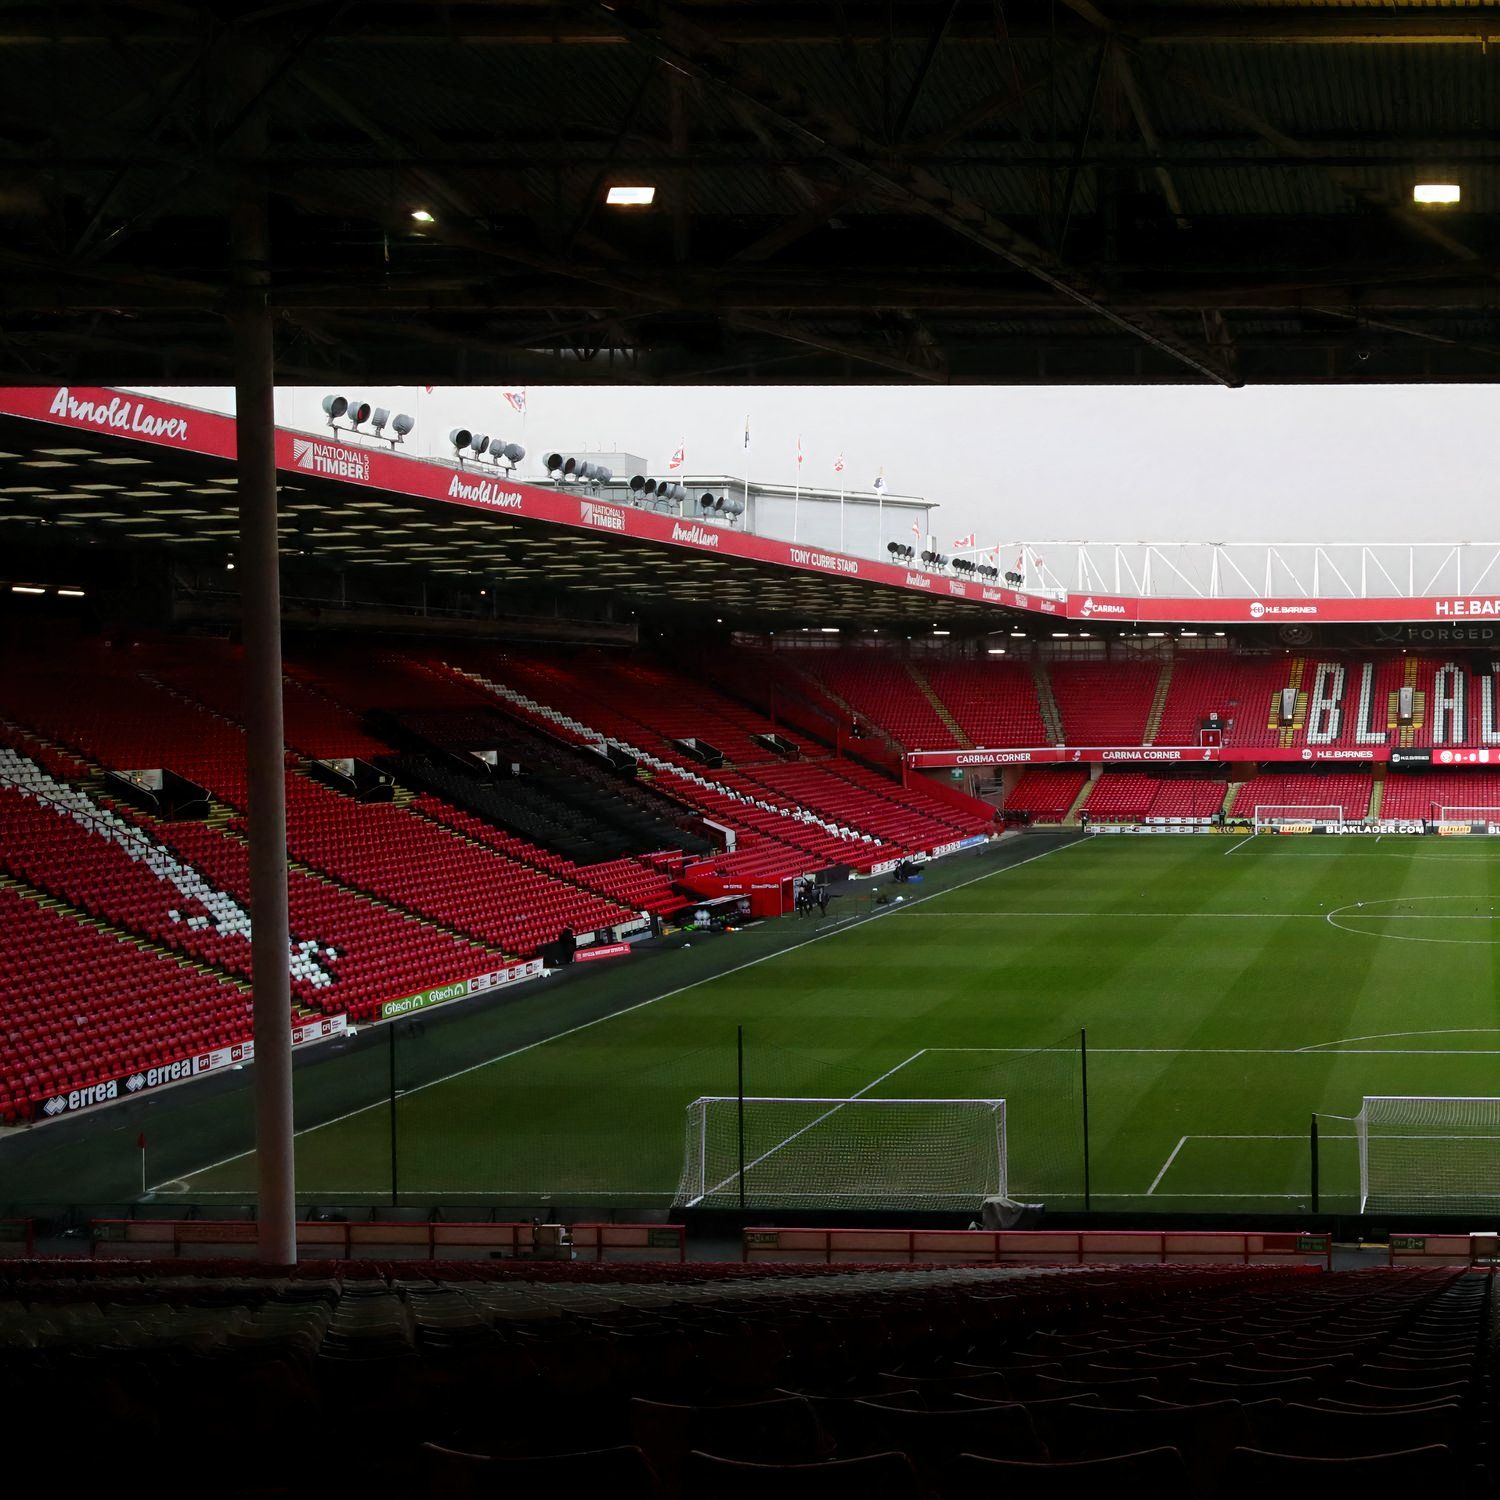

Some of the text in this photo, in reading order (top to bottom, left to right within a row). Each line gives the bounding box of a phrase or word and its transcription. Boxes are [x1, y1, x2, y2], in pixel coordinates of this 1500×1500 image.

[49, 387, 187, 440] Arnold Laver
[314, 443, 363, 464] NATIONAL
[314, 456, 363, 479] TIMBER
[448, 475, 522, 509] Arnold Laver
[592, 514, 622, 530] TIMBER
[790, 548, 858, 573] TONY CURRIE STAND
[1092, 604, 1125, 613] CARRMA
[1265, 606, 1317, 614] H.E.BARNES
[1409, 628, 1494, 640] FORGED
[956, 753, 1031, 763] CARRMA CORNER
[1102, 751, 1180, 759] CARRMA CORNER
[1317, 750, 1373, 758] H.E.BARNES
[1326, 825, 1424, 834] BLAKLADER.COM
[429, 987, 453, 1002] Gtech
[385, 1000, 412, 1015] Gtech
[147, 1059, 193, 1087] errea
[68, 1080, 118, 1110] errea
